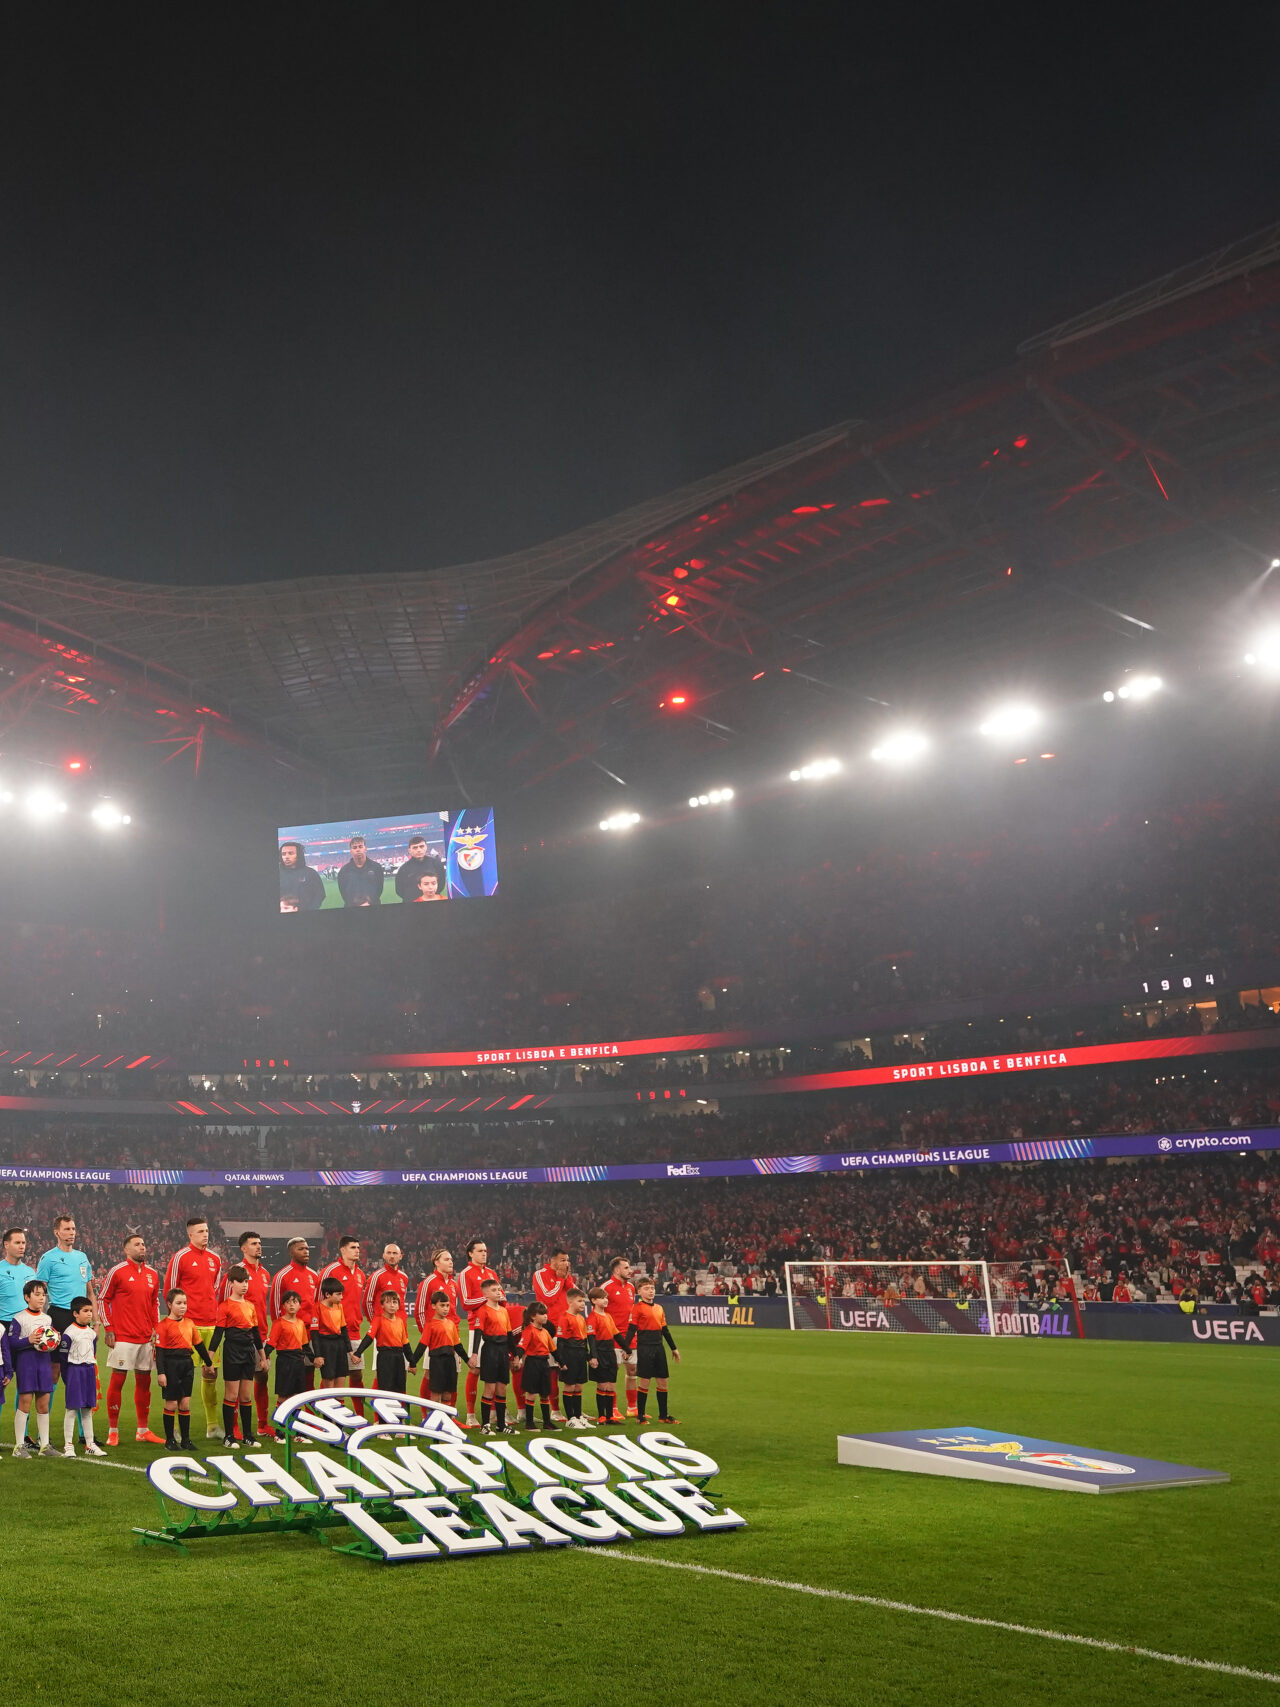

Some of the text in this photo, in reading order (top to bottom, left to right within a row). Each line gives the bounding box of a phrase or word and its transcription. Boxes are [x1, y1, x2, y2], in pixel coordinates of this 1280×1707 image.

[477, 1045, 619, 1063] SPORT LISBOA E BENFICA
[893, 1053, 1067, 1080] SPORT LISBOA E BENFICA
[1175, 1135, 1251, 1149] crypto.com
[841, 1148, 990, 1167] UEFA CHAMPIONS LEAGUE
[19, 1169, 73, 1180] CHAMPIONS
[74, 1171, 111, 1181] LEAGUE
[224, 1173, 285, 1182] QATAR AIRWAYS
[401, 1171, 528, 1182] UEFA CHAMPIONS LEAGUE
[666, 1164, 700, 1176] FedEx
[678, 1305, 755, 1326] WELCOME ALL
[840, 1310, 890, 1329] UEFA
[1191, 1318, 1265, 1342] UEFA
[147, 1431, 721, 1511] CHAMPIONS
[332, 1478, 748, 1562] LEAGUE
